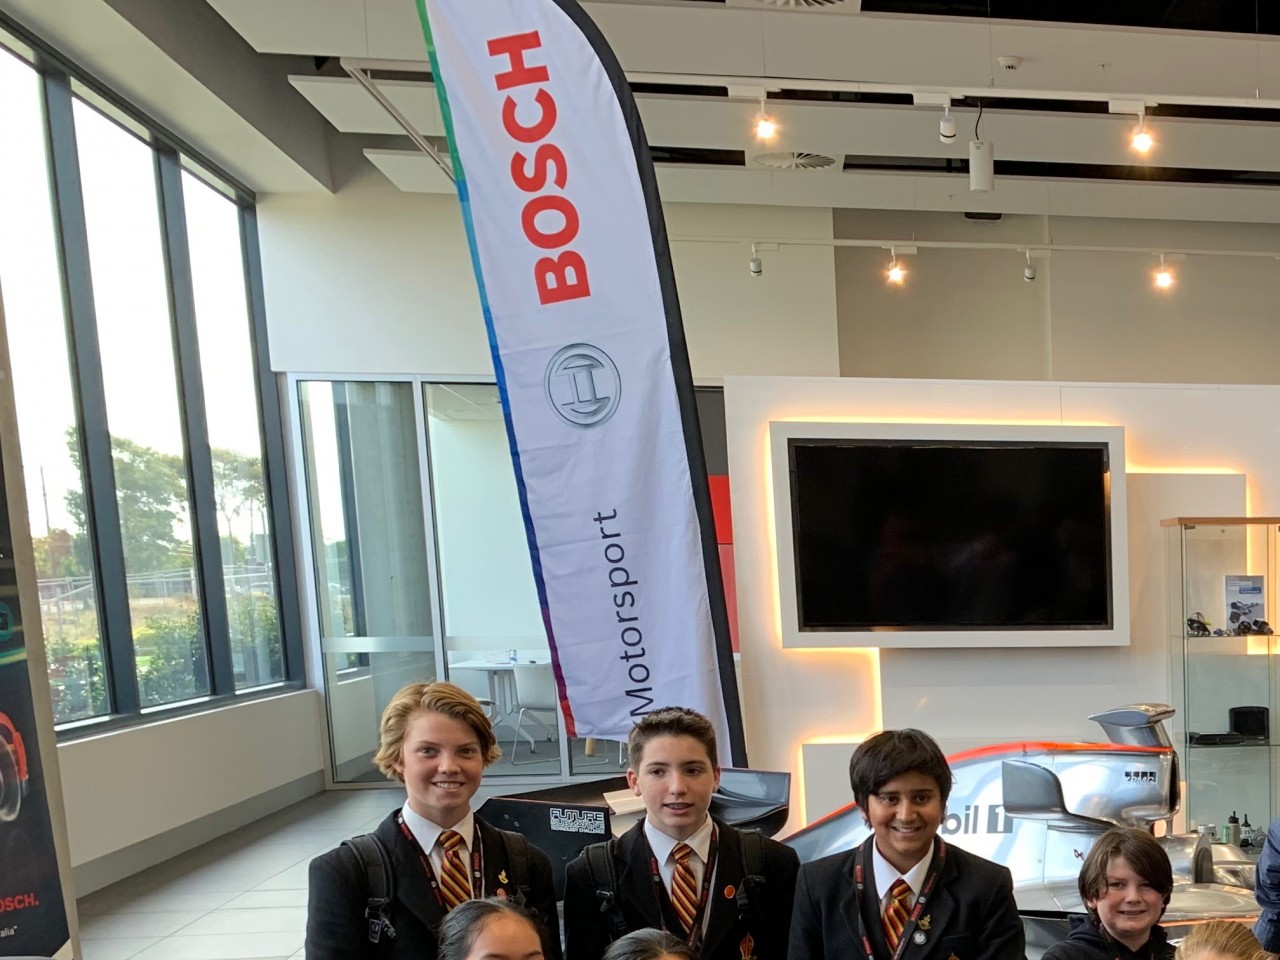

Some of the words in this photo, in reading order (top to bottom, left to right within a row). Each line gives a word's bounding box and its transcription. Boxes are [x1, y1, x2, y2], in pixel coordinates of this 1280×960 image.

[487, 30, 591, 305] BOSCH
[593, 508, 654, 717] Motorsport
[550, 808, 604, 820] FUTURE
